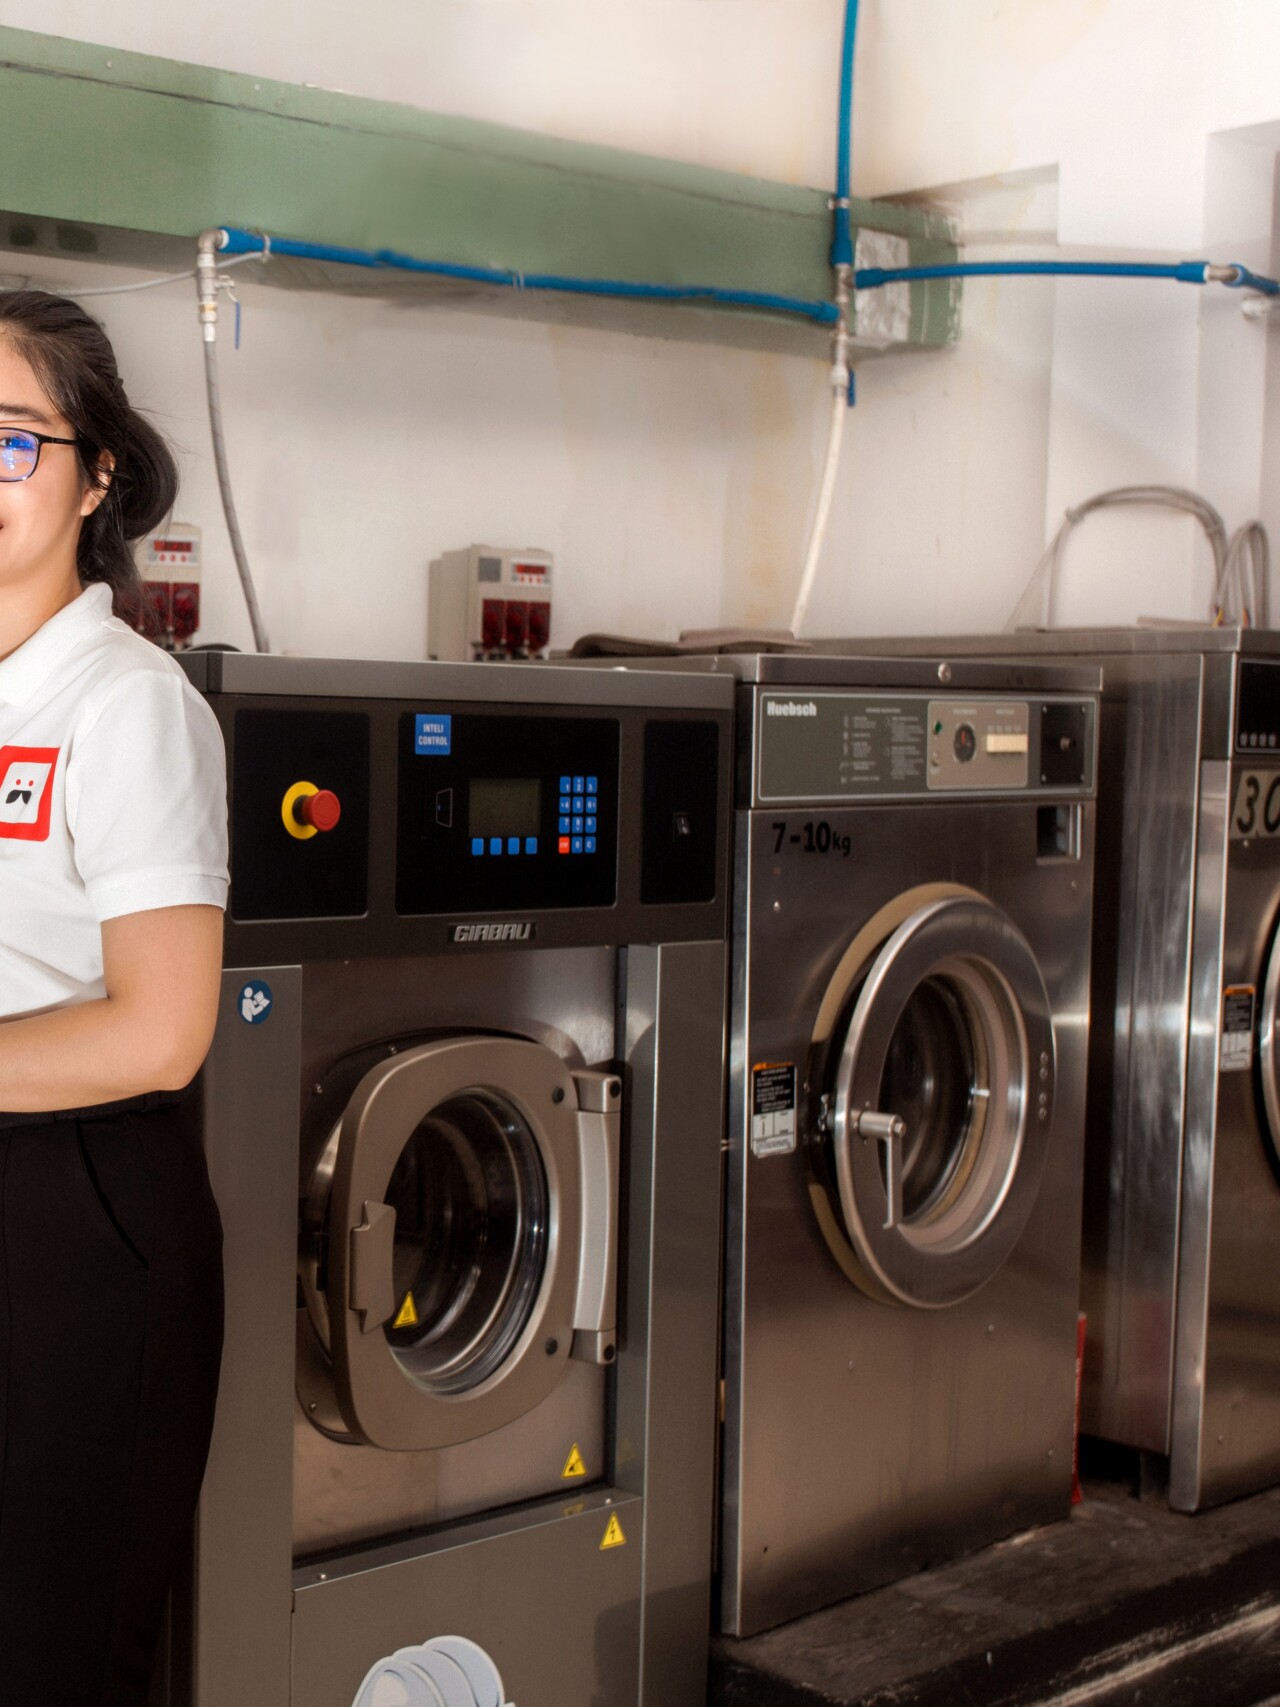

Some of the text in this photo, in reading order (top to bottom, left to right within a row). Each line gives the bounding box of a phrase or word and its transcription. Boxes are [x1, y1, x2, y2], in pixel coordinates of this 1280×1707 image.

[767, 701, 817, 716] Huebsch
[418, 735, 448, 746] CONTROL
[453, 923, 531, 942] GIRBAU
